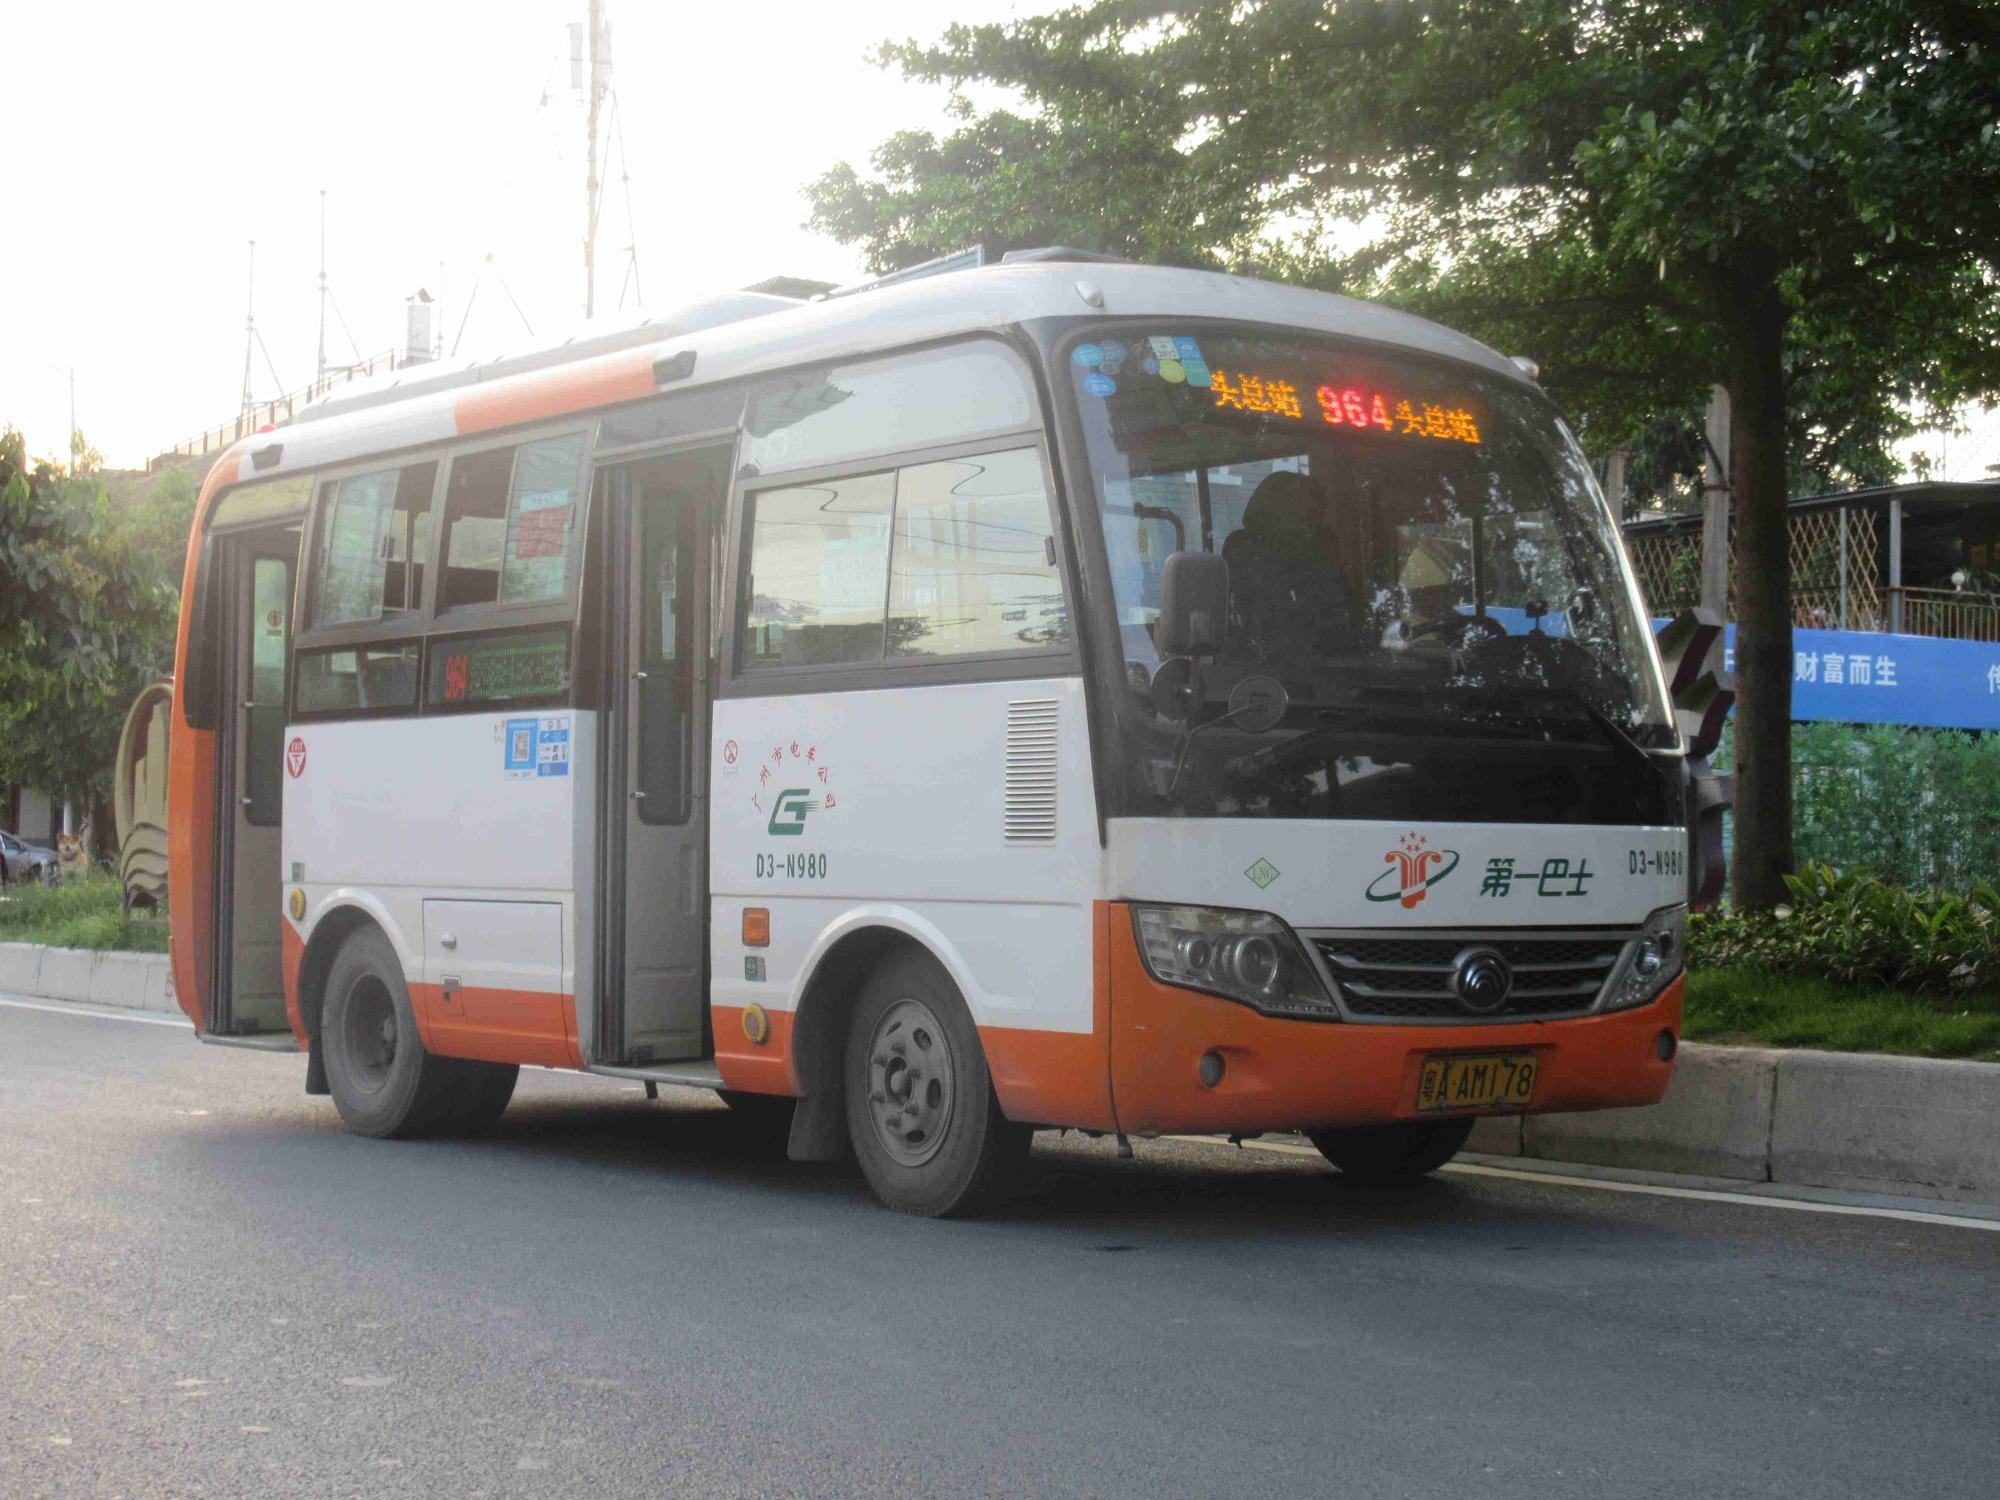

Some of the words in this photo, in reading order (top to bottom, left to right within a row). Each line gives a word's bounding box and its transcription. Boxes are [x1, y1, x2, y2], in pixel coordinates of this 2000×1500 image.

[1209, 370, 1303, 417] 头总站
[1316, 385, 1393, 431] 964
[1395, 399, 1483, 443] 头总站
[1795, 651, 1898, 687] 财富而生
[756, 852, 828, 879] D3-N980
[1480, 858, 1594, 897] 第一巴士
[1629, 849, 1683, 875] D3-N980
